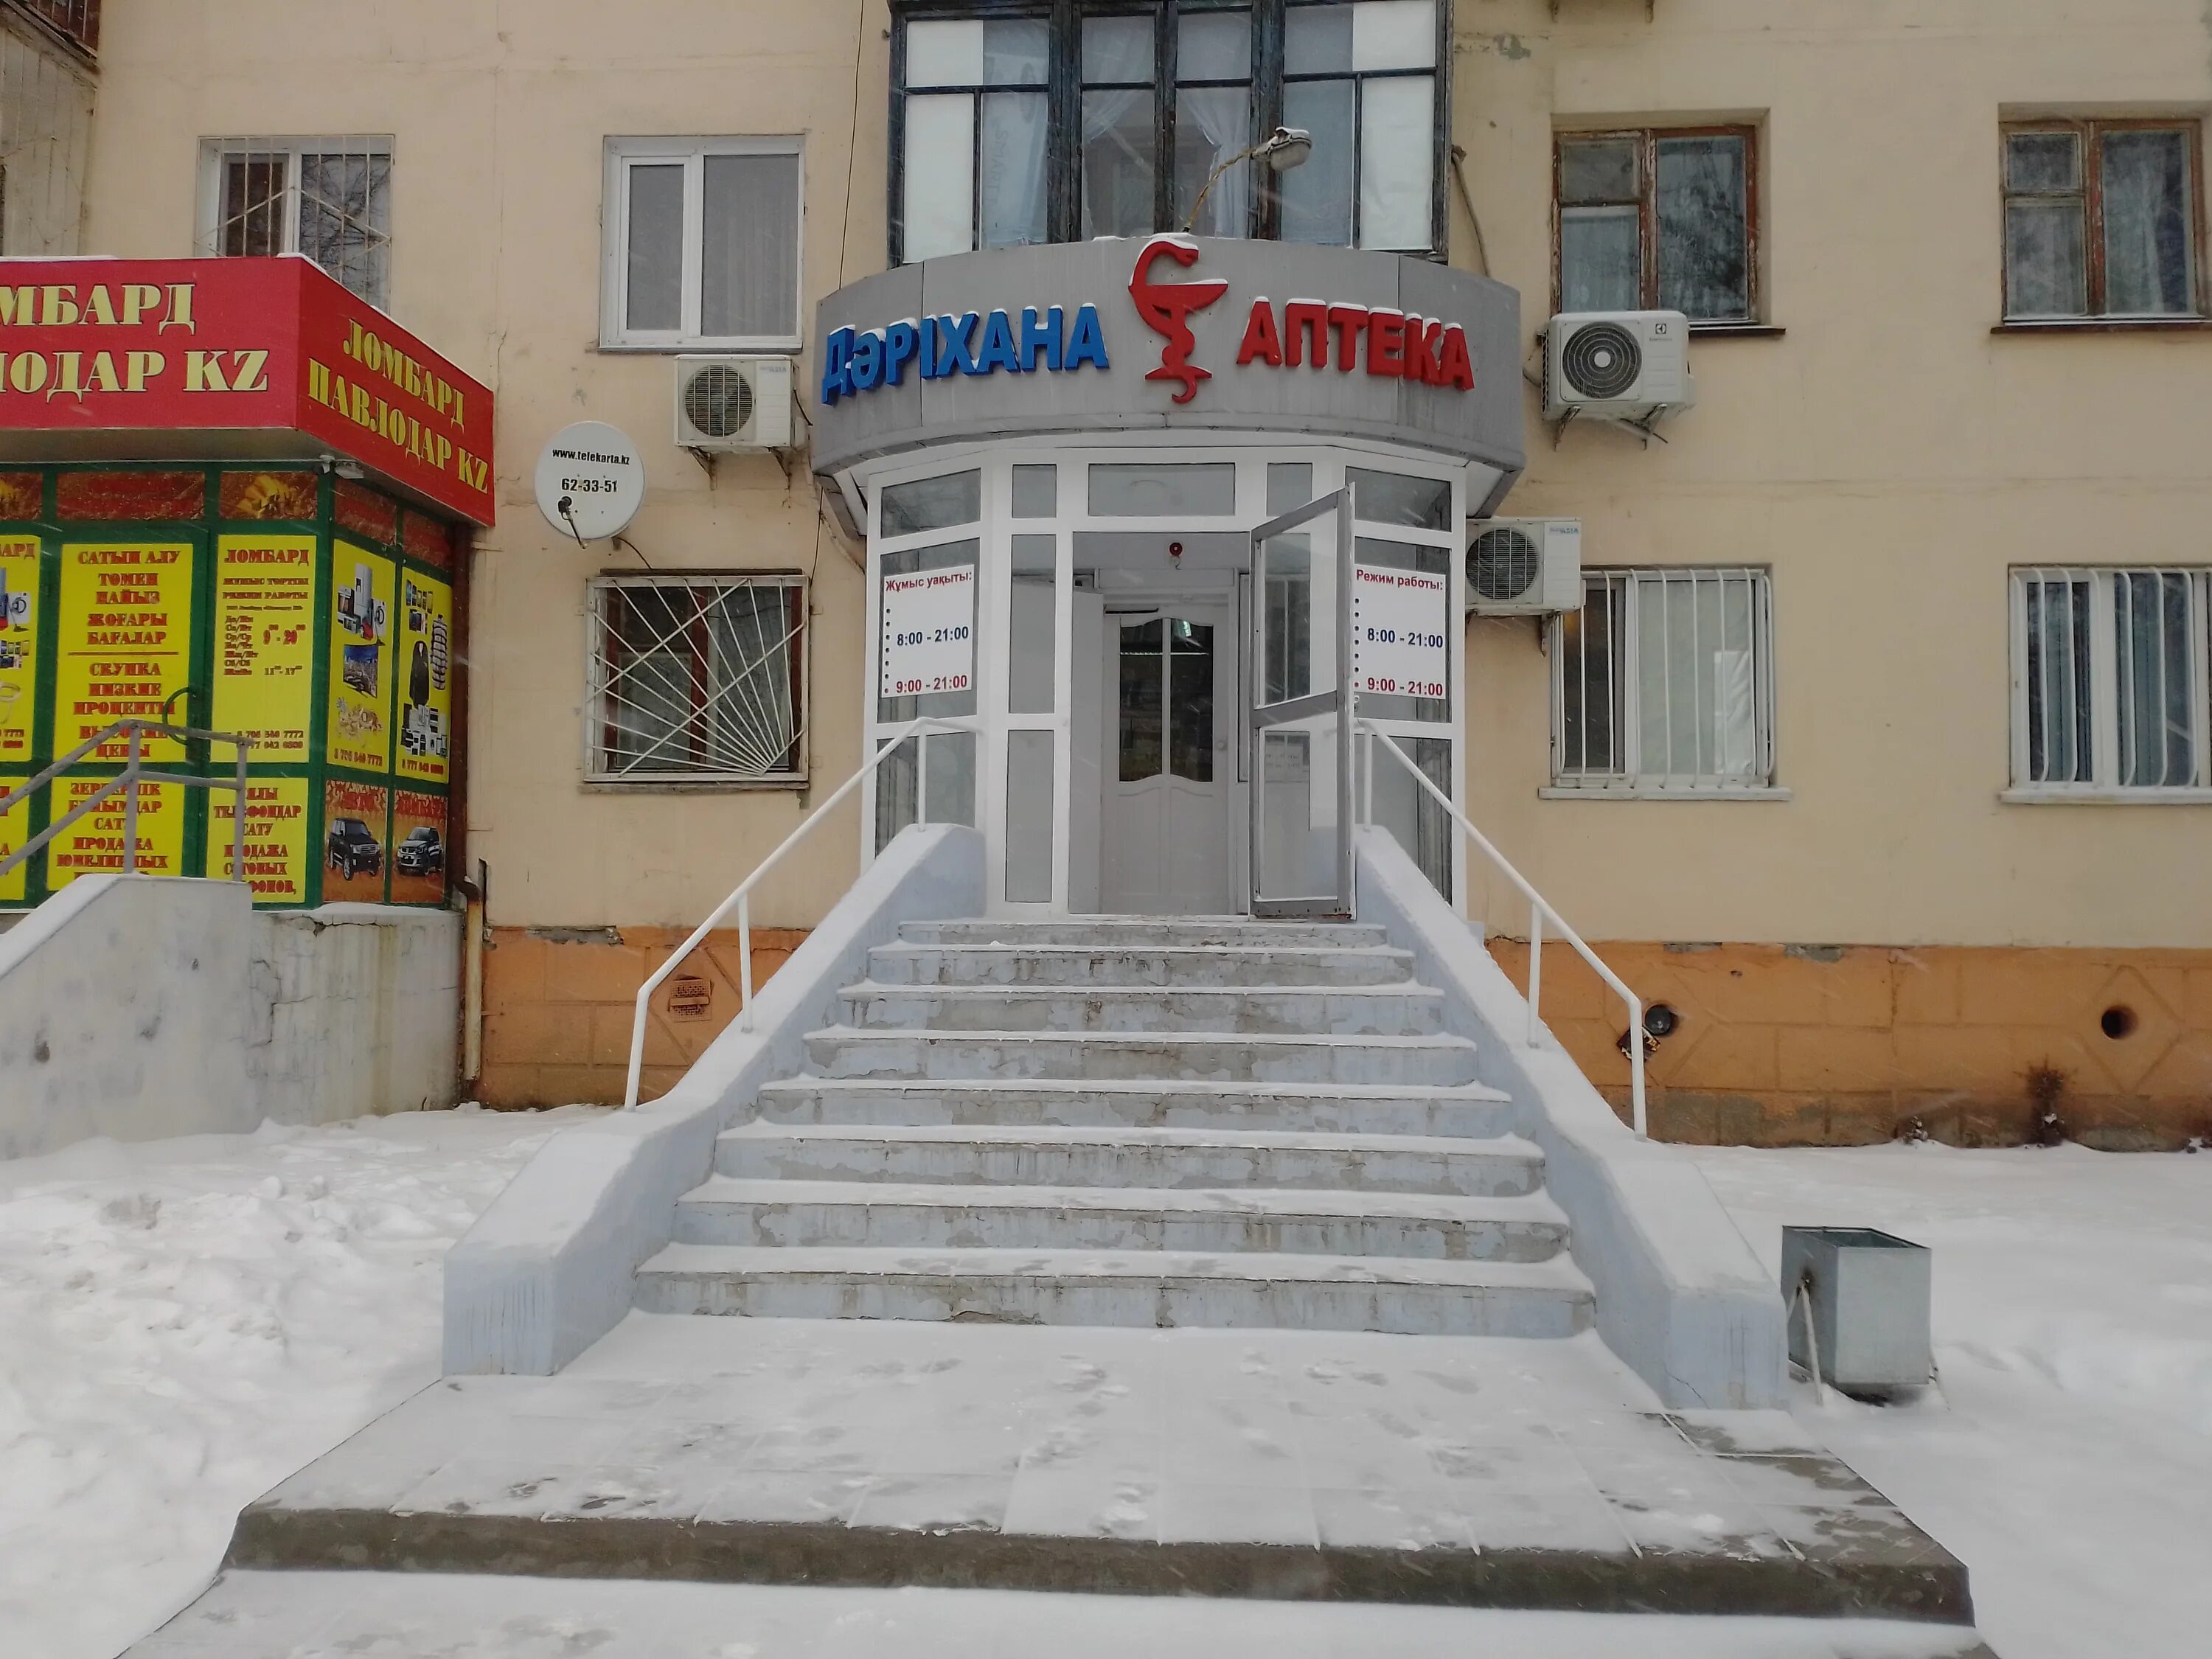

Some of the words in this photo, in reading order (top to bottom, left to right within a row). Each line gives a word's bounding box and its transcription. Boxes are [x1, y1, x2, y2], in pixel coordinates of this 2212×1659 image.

[1237, 298, 1475, 391] АПТЕКА
[821, 304, 1110, 405] ДӘРІХАНА
[0, 350, 166, 403] ОДАР
[183, 350, 269, 392] KZ
[343, 318, 465, 434] ЛОМБАРД
[307, 358, 452, 471] ПАВЛОДАР
[458, 447, 488, 494] KZ
[552, 449, 630, 465] www.telekarta.kz
[561, 479, 617, 493] 62-33-51
[0, 543, 35, 560] АРД
[78, 551, 141, 564] САТЫП
[145, 550, 180, 564] АЛУ
[224, 549, 309, 566] ЛОМБАРД
[886, 578, 924, 592] Жұмыс
[927, 571, 972, 588] уақыты:
[1356, 569, 1394, 585] Режим
[1397, 577, 1443, 591] работы:
[88, 613, 167, 627] ЖОҒАРЫ
[87, 631, 167, 644] БАҒАЛАР
[897, 631, 922, 646] 8:00
[934, 626, 969, 643] 21:00
[1368, 627, 1395, 643] 8:00
[1408, 632, 1443, 648] 21:00
[89, 662, 161, 676] СКУПКА
[88, 683, 161, 696] НИЗКИЕ
[896, 679, 922, 693] 9:00
[933, 675, 967, 690] 21:00
[1367, 677, 1395, 692] 9:00
[1408, 681, 1443, 696] 21:00
[74, 701, 175, 717] ПРОЦЕНТЫ
[247, 787, 278, 800] ЯЛЫ
[214, 806, 302, 820] ТЕЛФОНДАР
[94, 818, 127, 830] САТ
[224, 844, 288, 860] ПОДАЖА
[223, 862, 288, 875] СТОВЫХ
